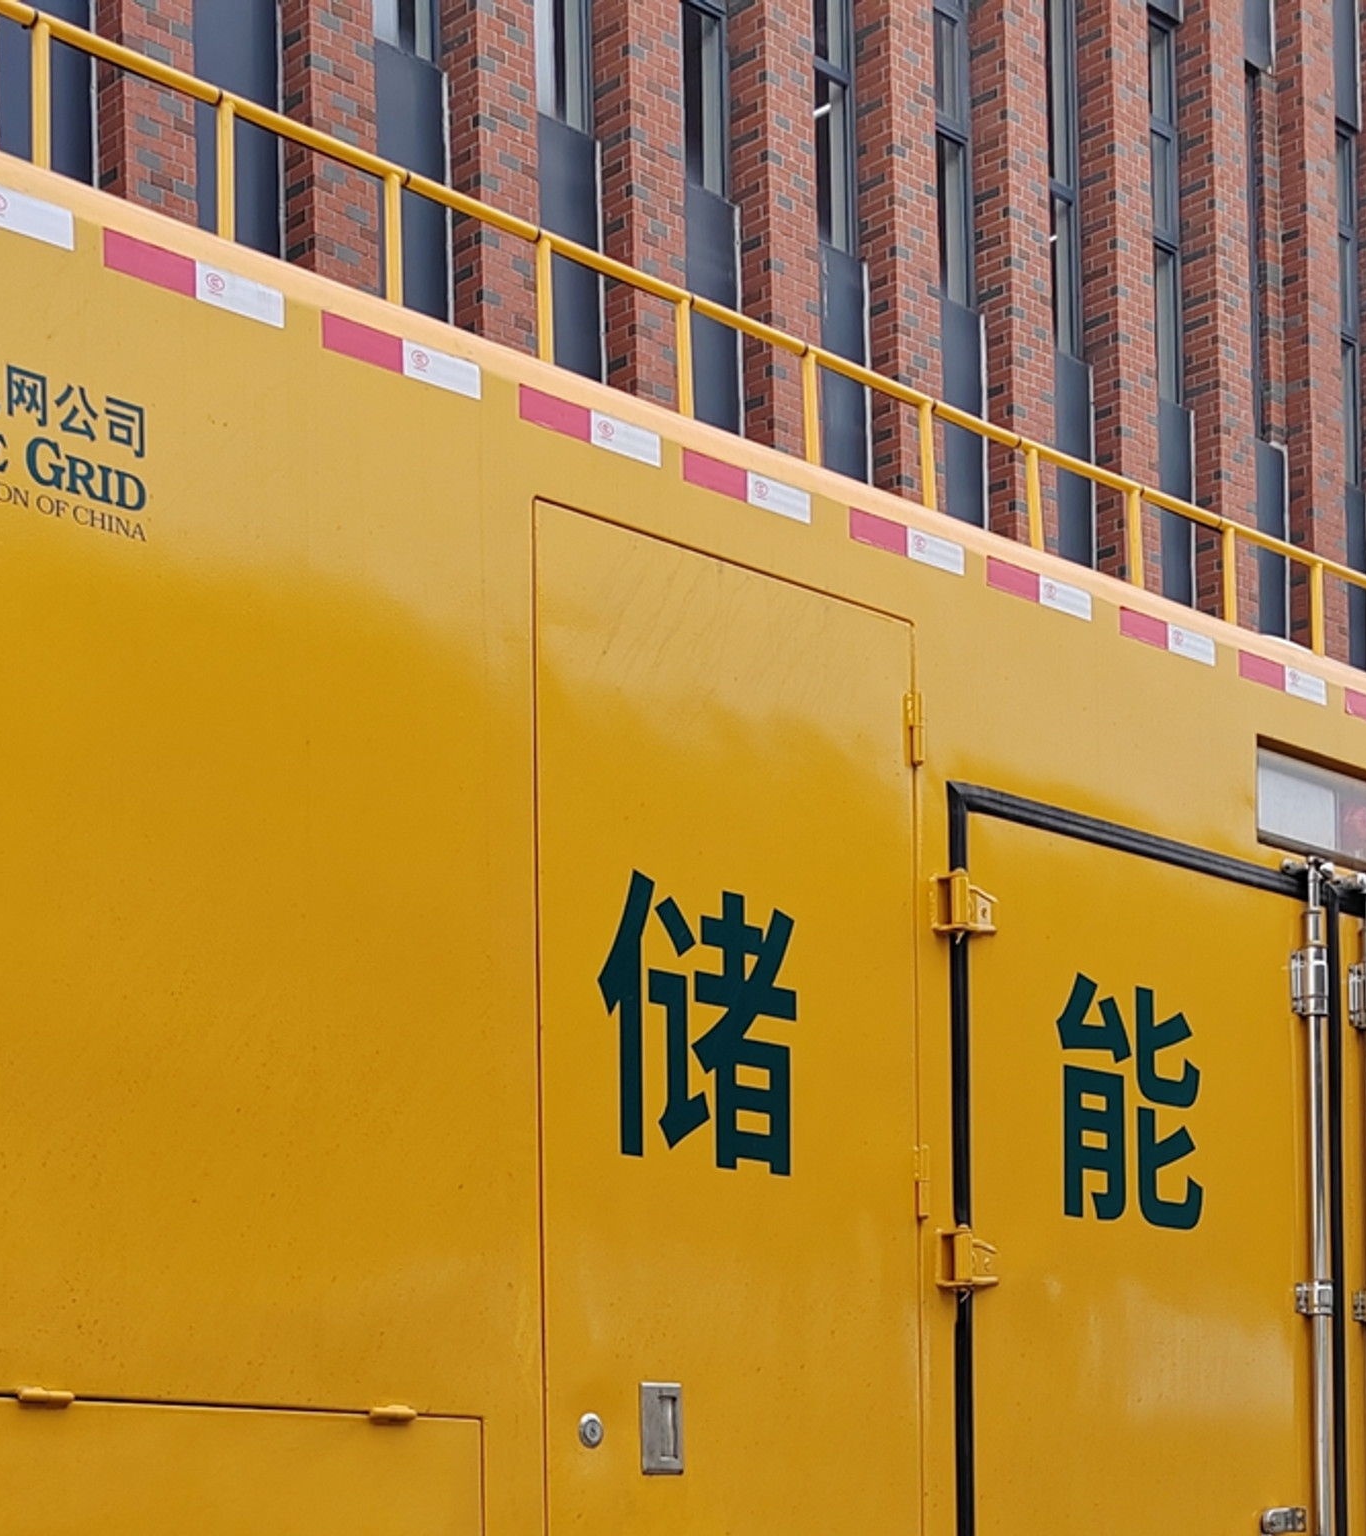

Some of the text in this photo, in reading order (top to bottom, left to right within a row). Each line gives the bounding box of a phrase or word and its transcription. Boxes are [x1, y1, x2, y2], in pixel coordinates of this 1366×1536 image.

[25, 436, 146, 511] GRID
[36, 494, 69, 518] OF
[72, 504, 147, 541] CHINA
